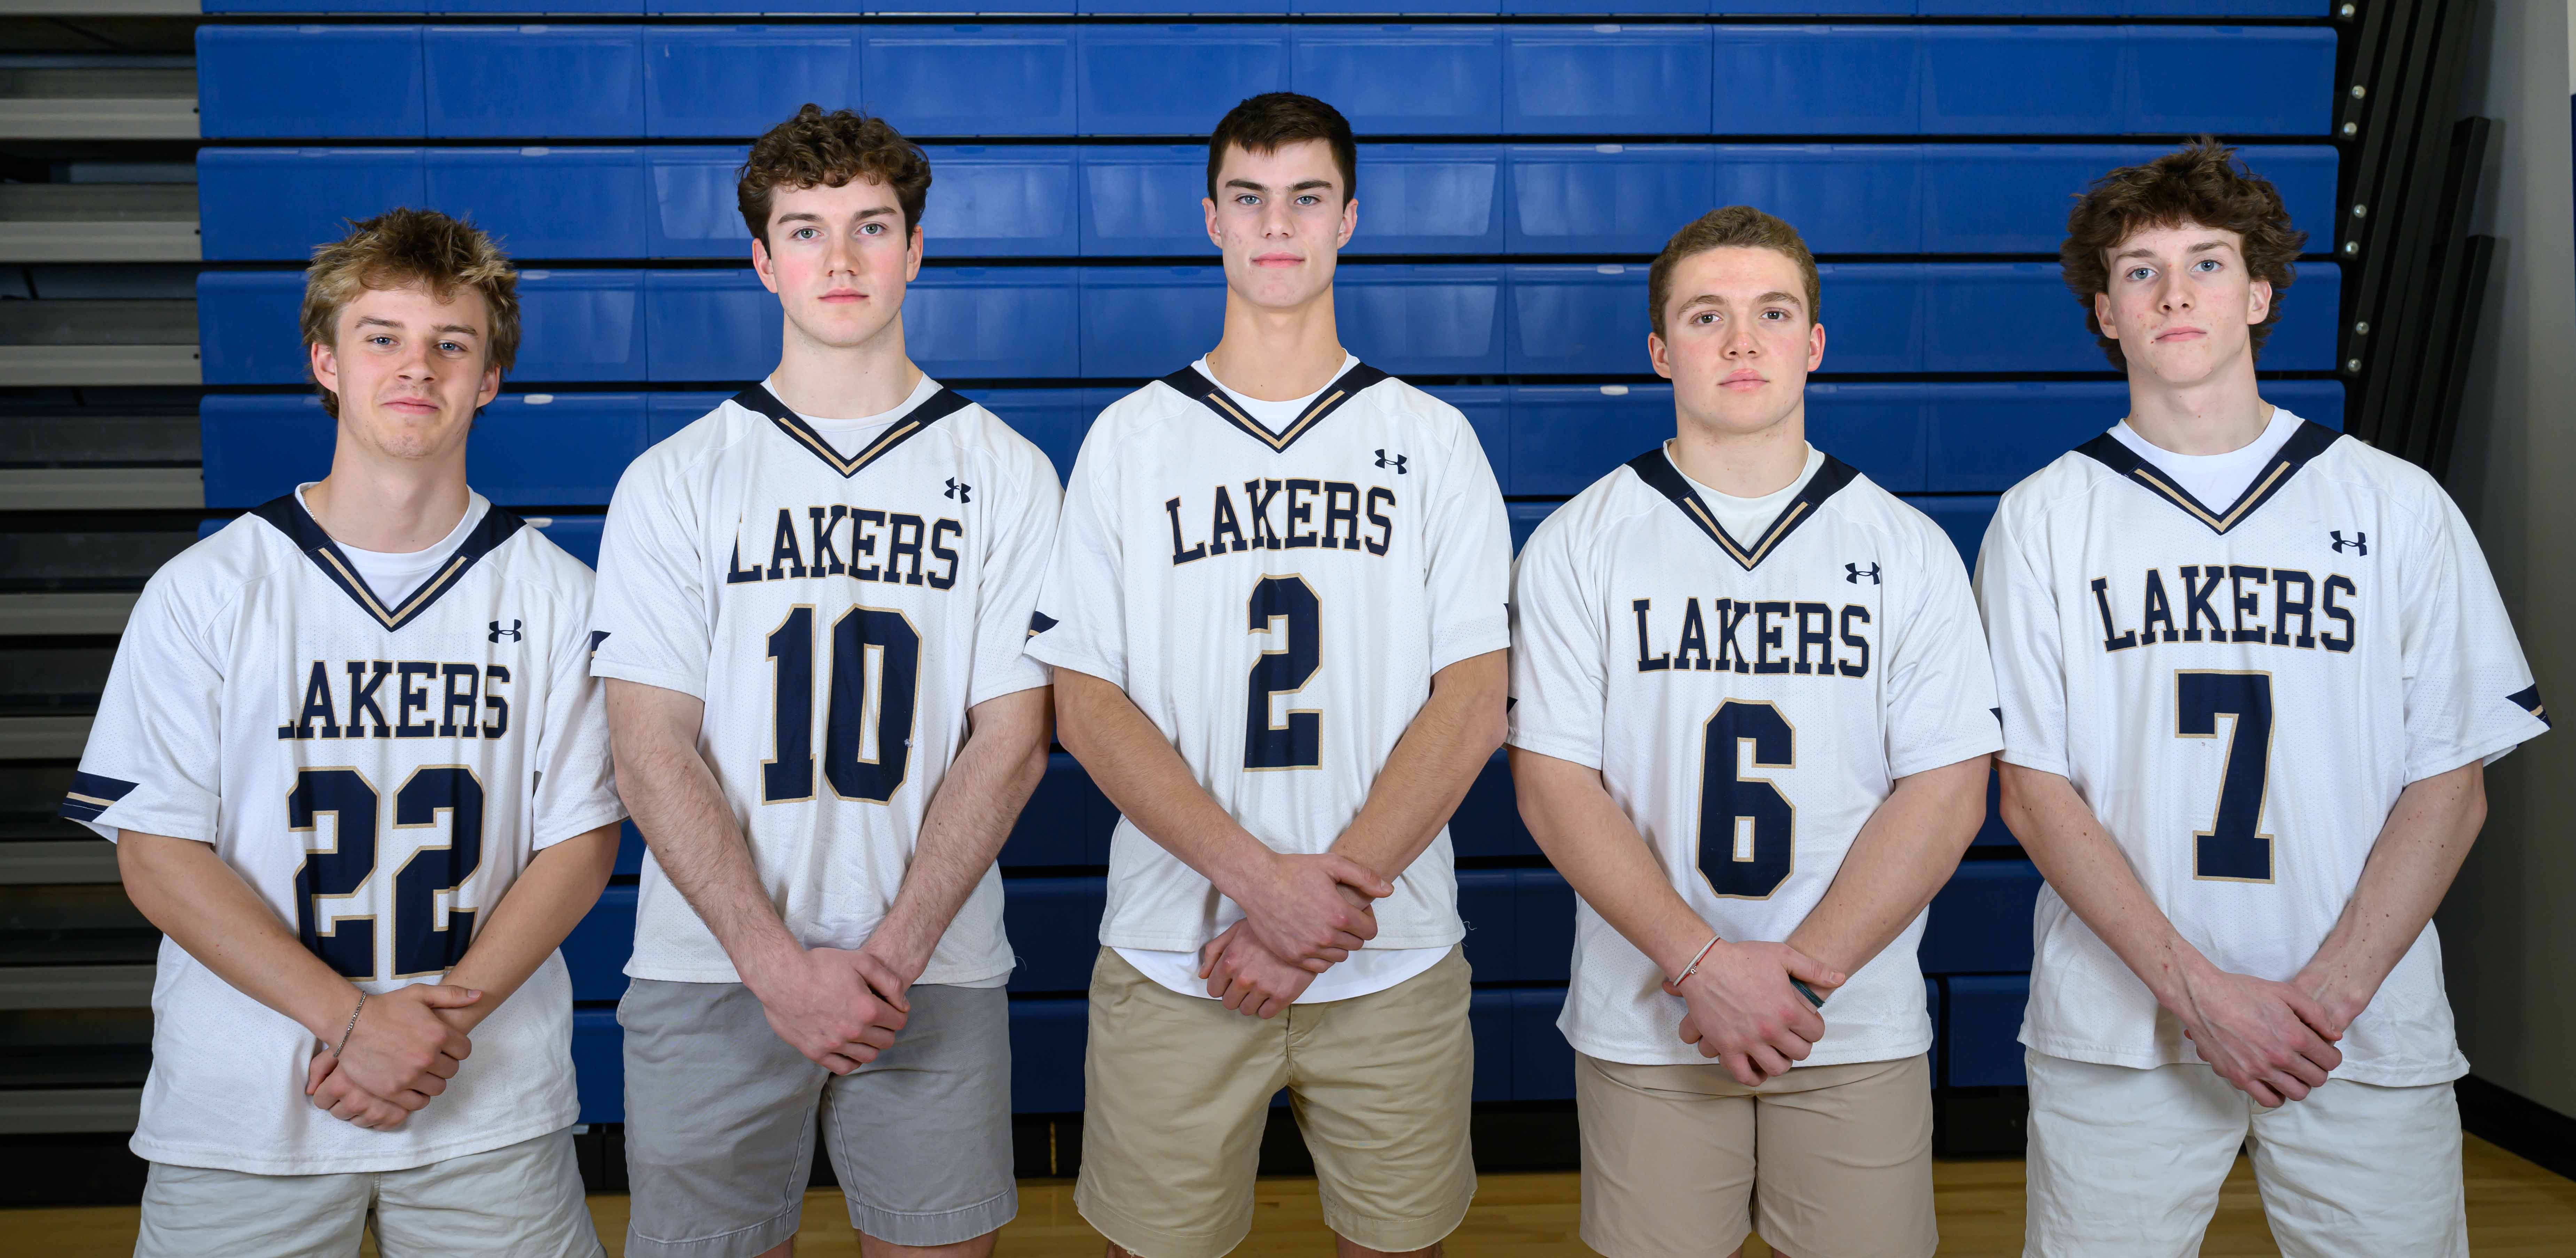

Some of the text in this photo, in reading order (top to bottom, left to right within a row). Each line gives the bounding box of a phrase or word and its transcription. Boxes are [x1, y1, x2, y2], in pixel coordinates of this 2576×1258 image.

[726, 503, 964, 591] LAKERS
[1166, 477, 1396, 567] LAKERS
[2091, 564, 2357, 654] LAKERS
[760, 603, 923, 806] 10
[1243, 572, 1323, 772] 2
[1632, 597, 1872, 679] LAKERS
[285, 764, 486, 982] 22
[1694, 697, 1796, 901] 6
[2174, 669, 2275, 884] 7
